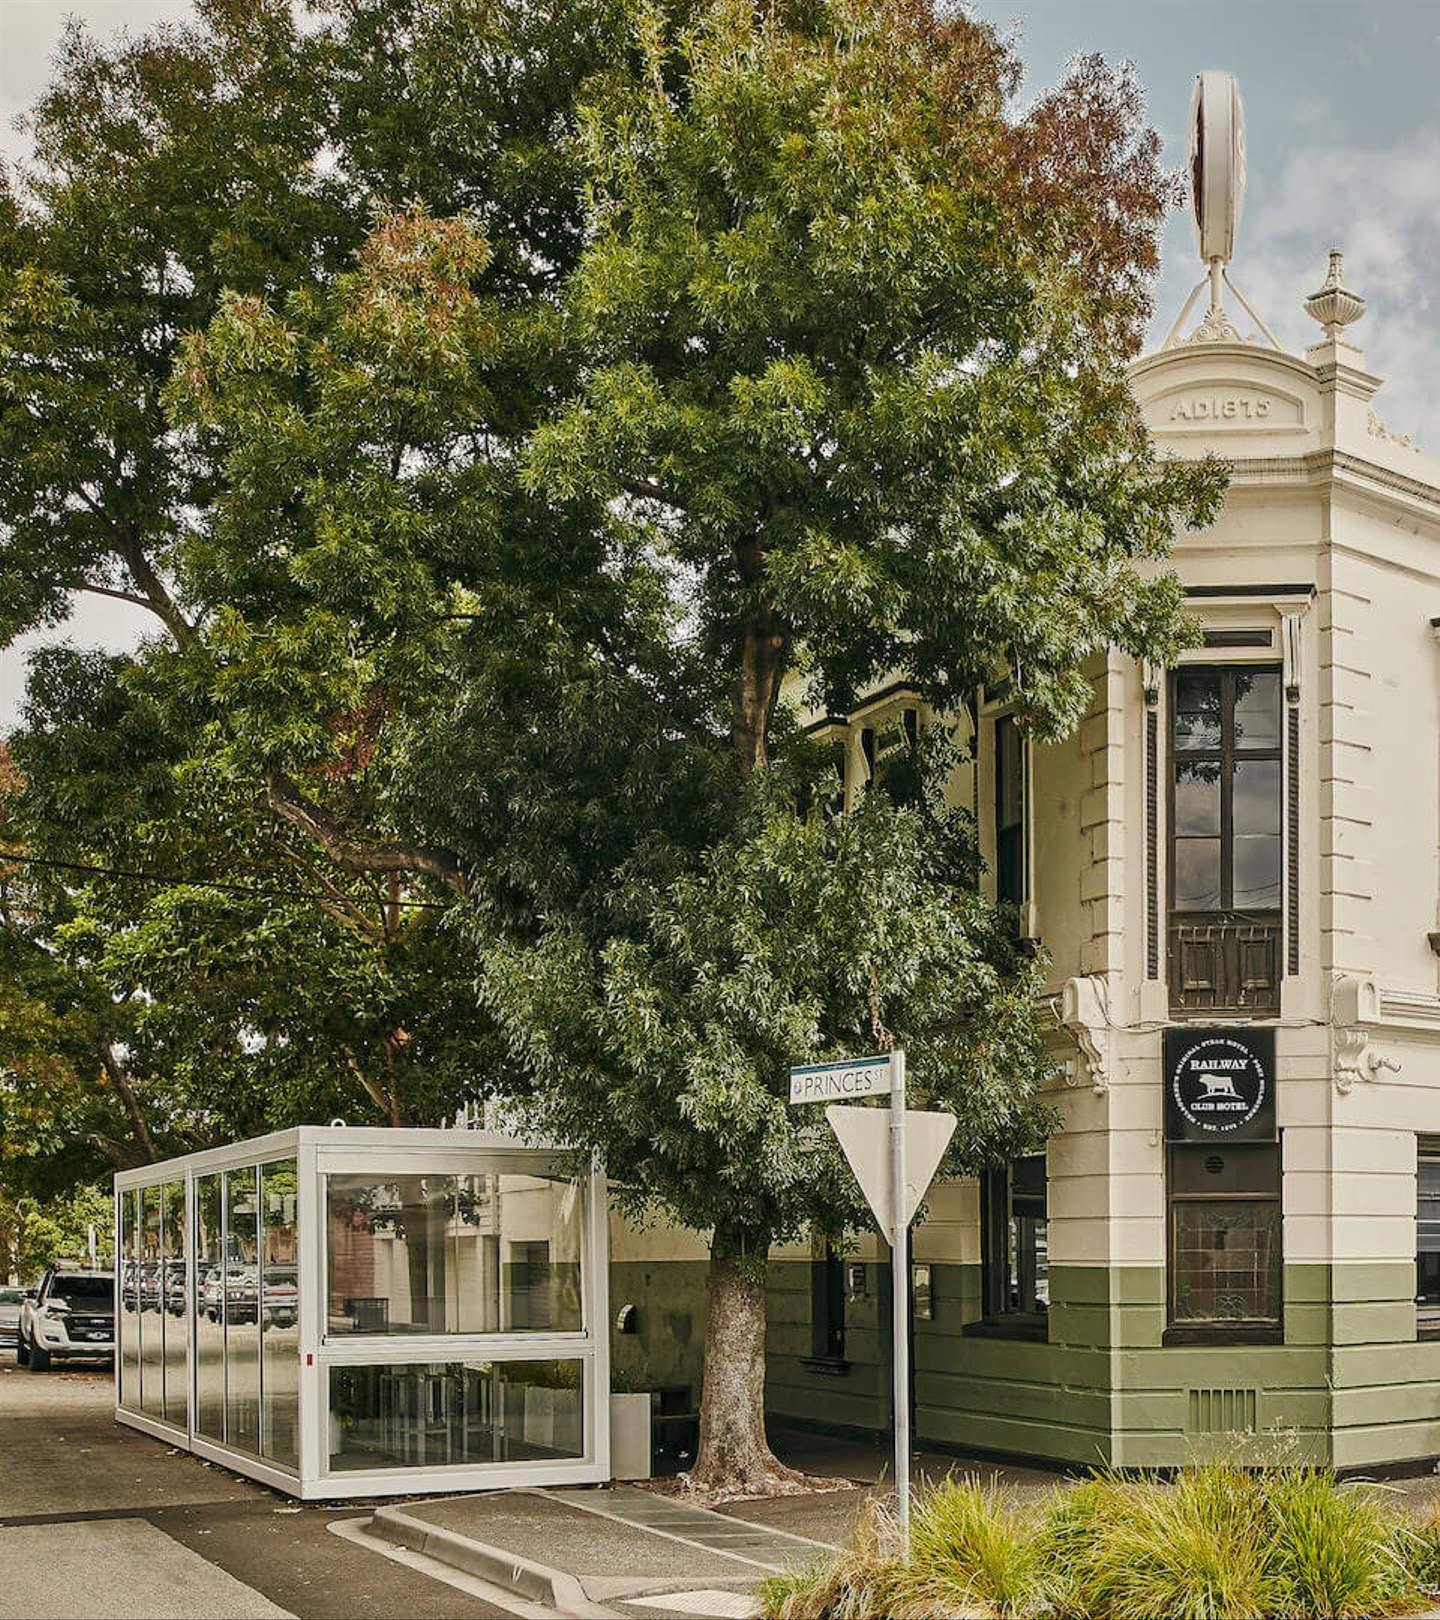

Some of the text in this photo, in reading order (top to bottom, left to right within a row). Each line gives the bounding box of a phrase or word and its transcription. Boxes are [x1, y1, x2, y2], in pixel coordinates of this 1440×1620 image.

[1190, 1059, 1249, 1070] RAILWAY
[804, 1070, 872, 1097] PRINCES
[1190, 1101, 1249, 1111] CLUB HOTEL
